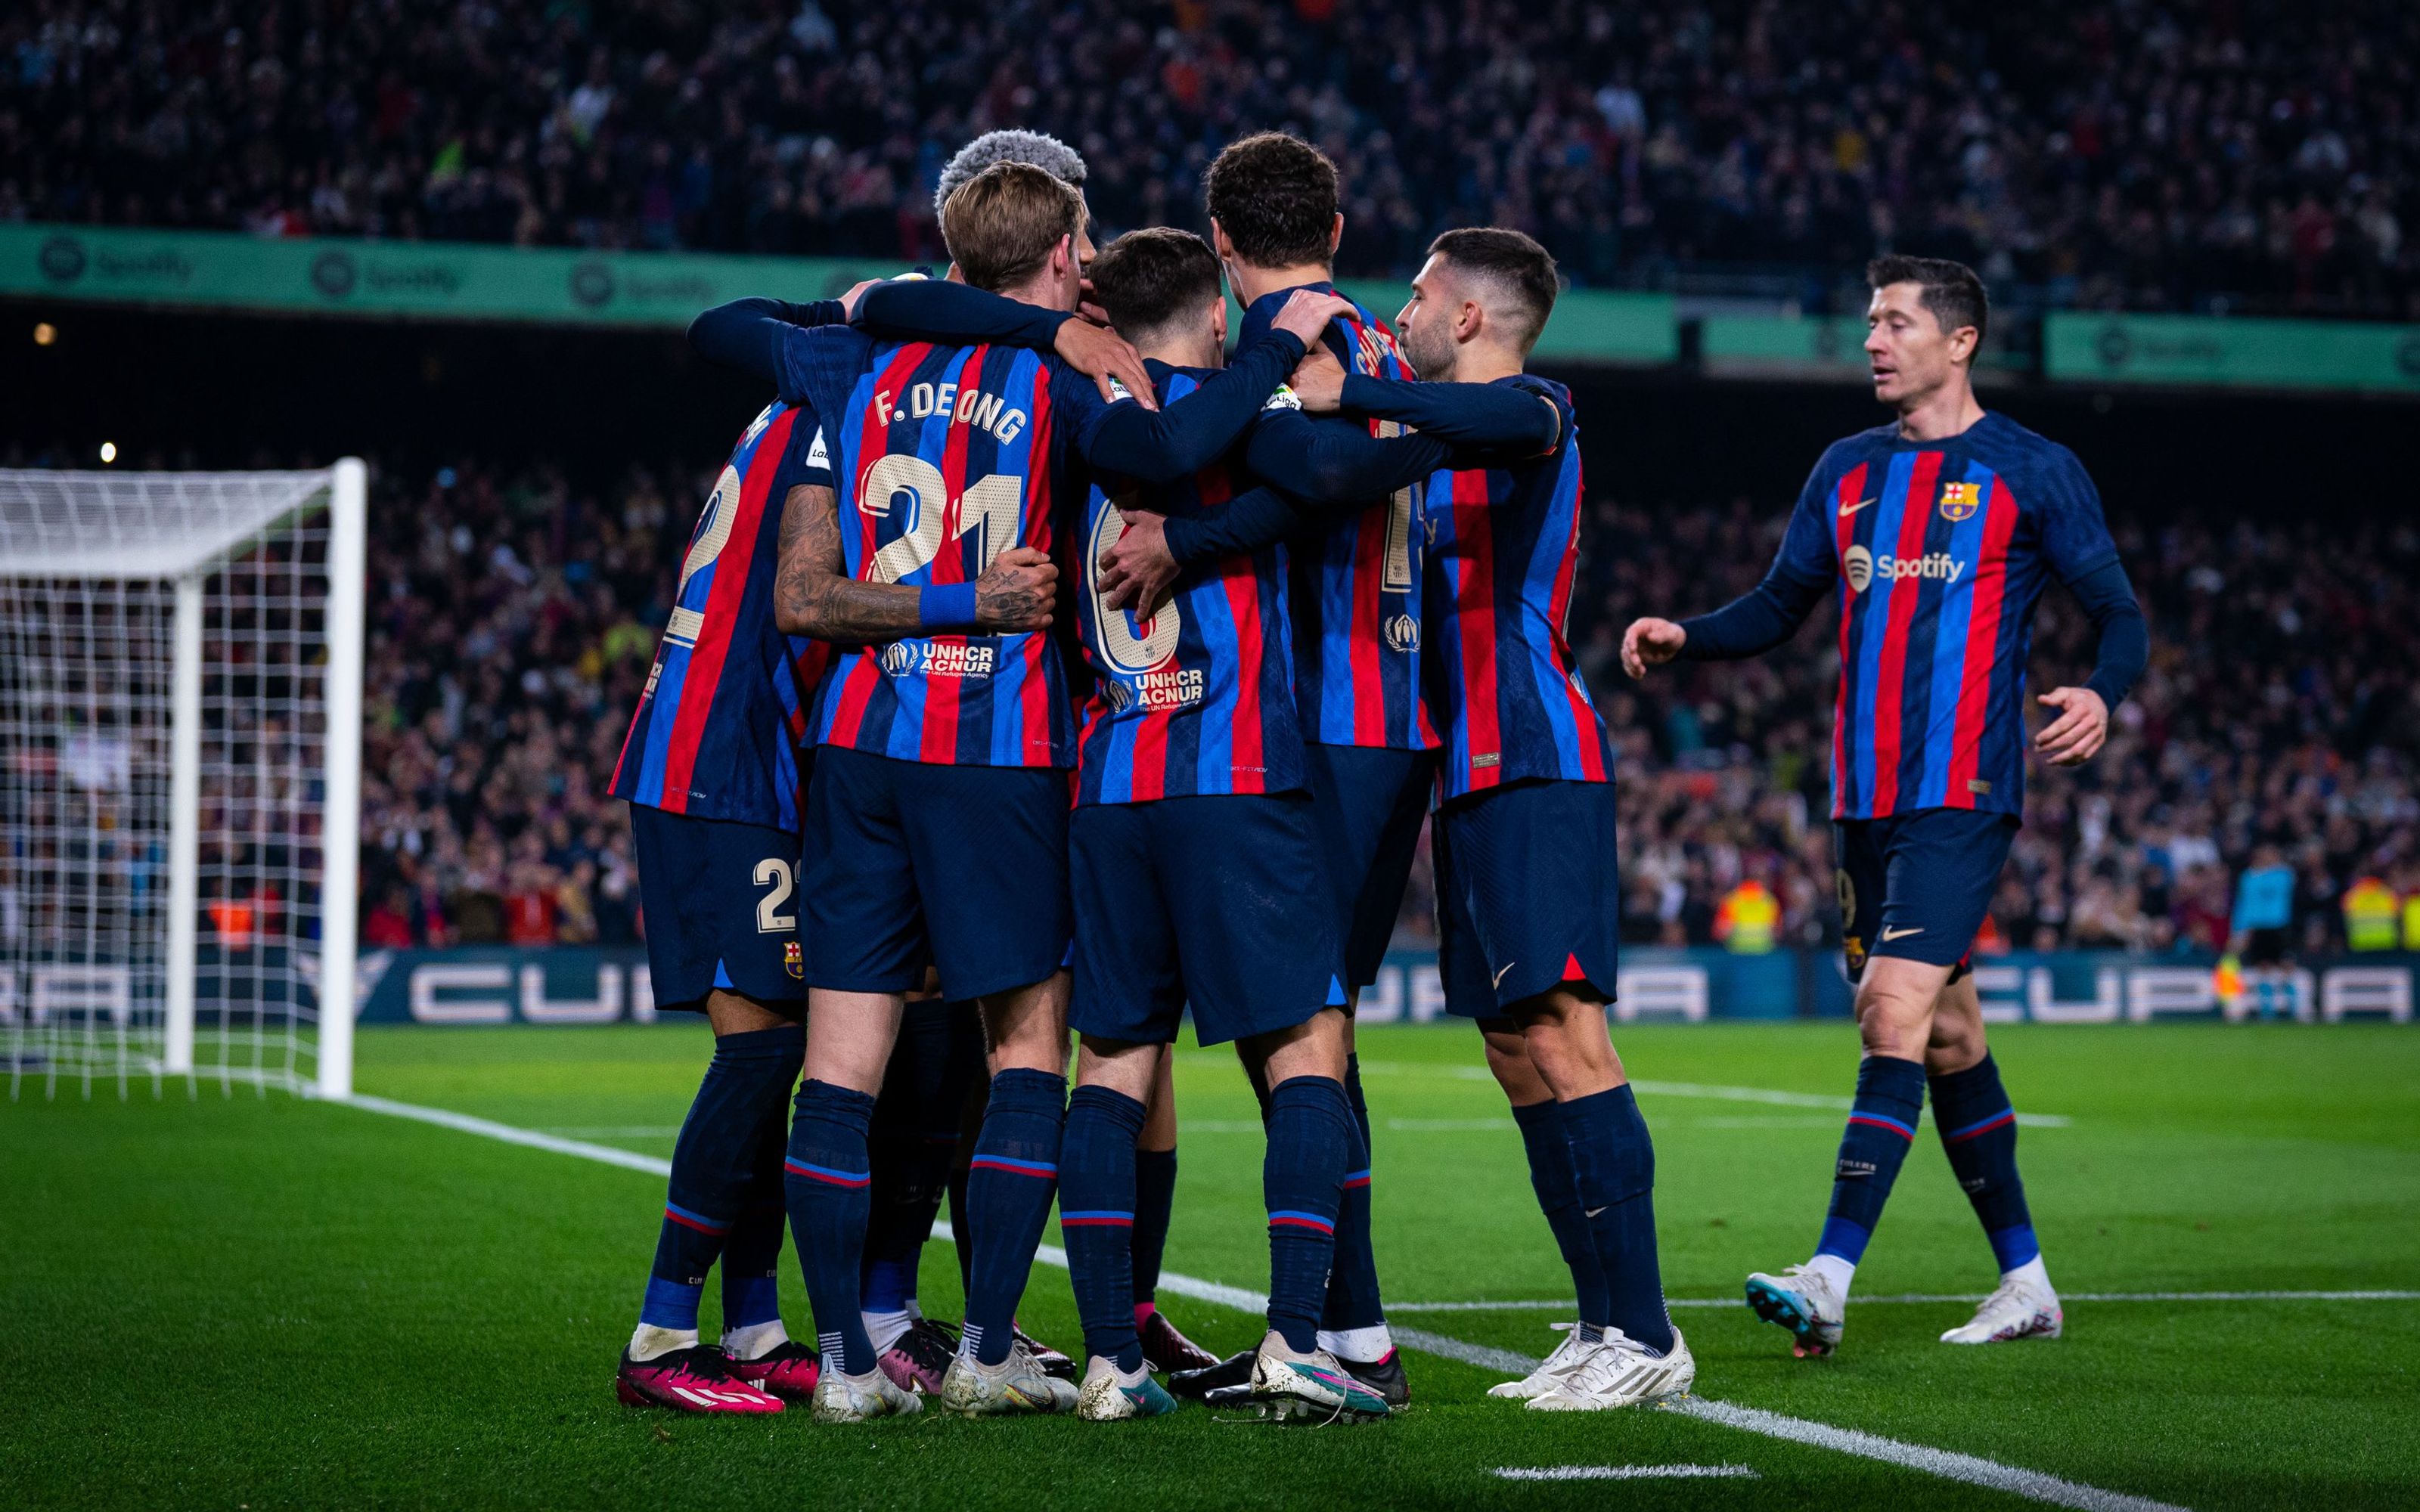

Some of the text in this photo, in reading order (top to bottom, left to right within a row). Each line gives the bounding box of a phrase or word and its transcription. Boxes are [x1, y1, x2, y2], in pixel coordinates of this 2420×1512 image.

[874, 389, 905, 427] F.
[948, 389, 1026, 445] ONG
[859, 454, 1022, 584] 21
[1877, 553, 1965, 583] Spotify
[919, 659, 992, 673] ACNUR
[923, 643, 994, 662] UNHCR
[1135, 669, 1203, 690] UNHCR
[1137, 685, 1203, 706] ACNUR
[753, 857, 802, 934] 2
[410, 962, 655, 1022] CU
